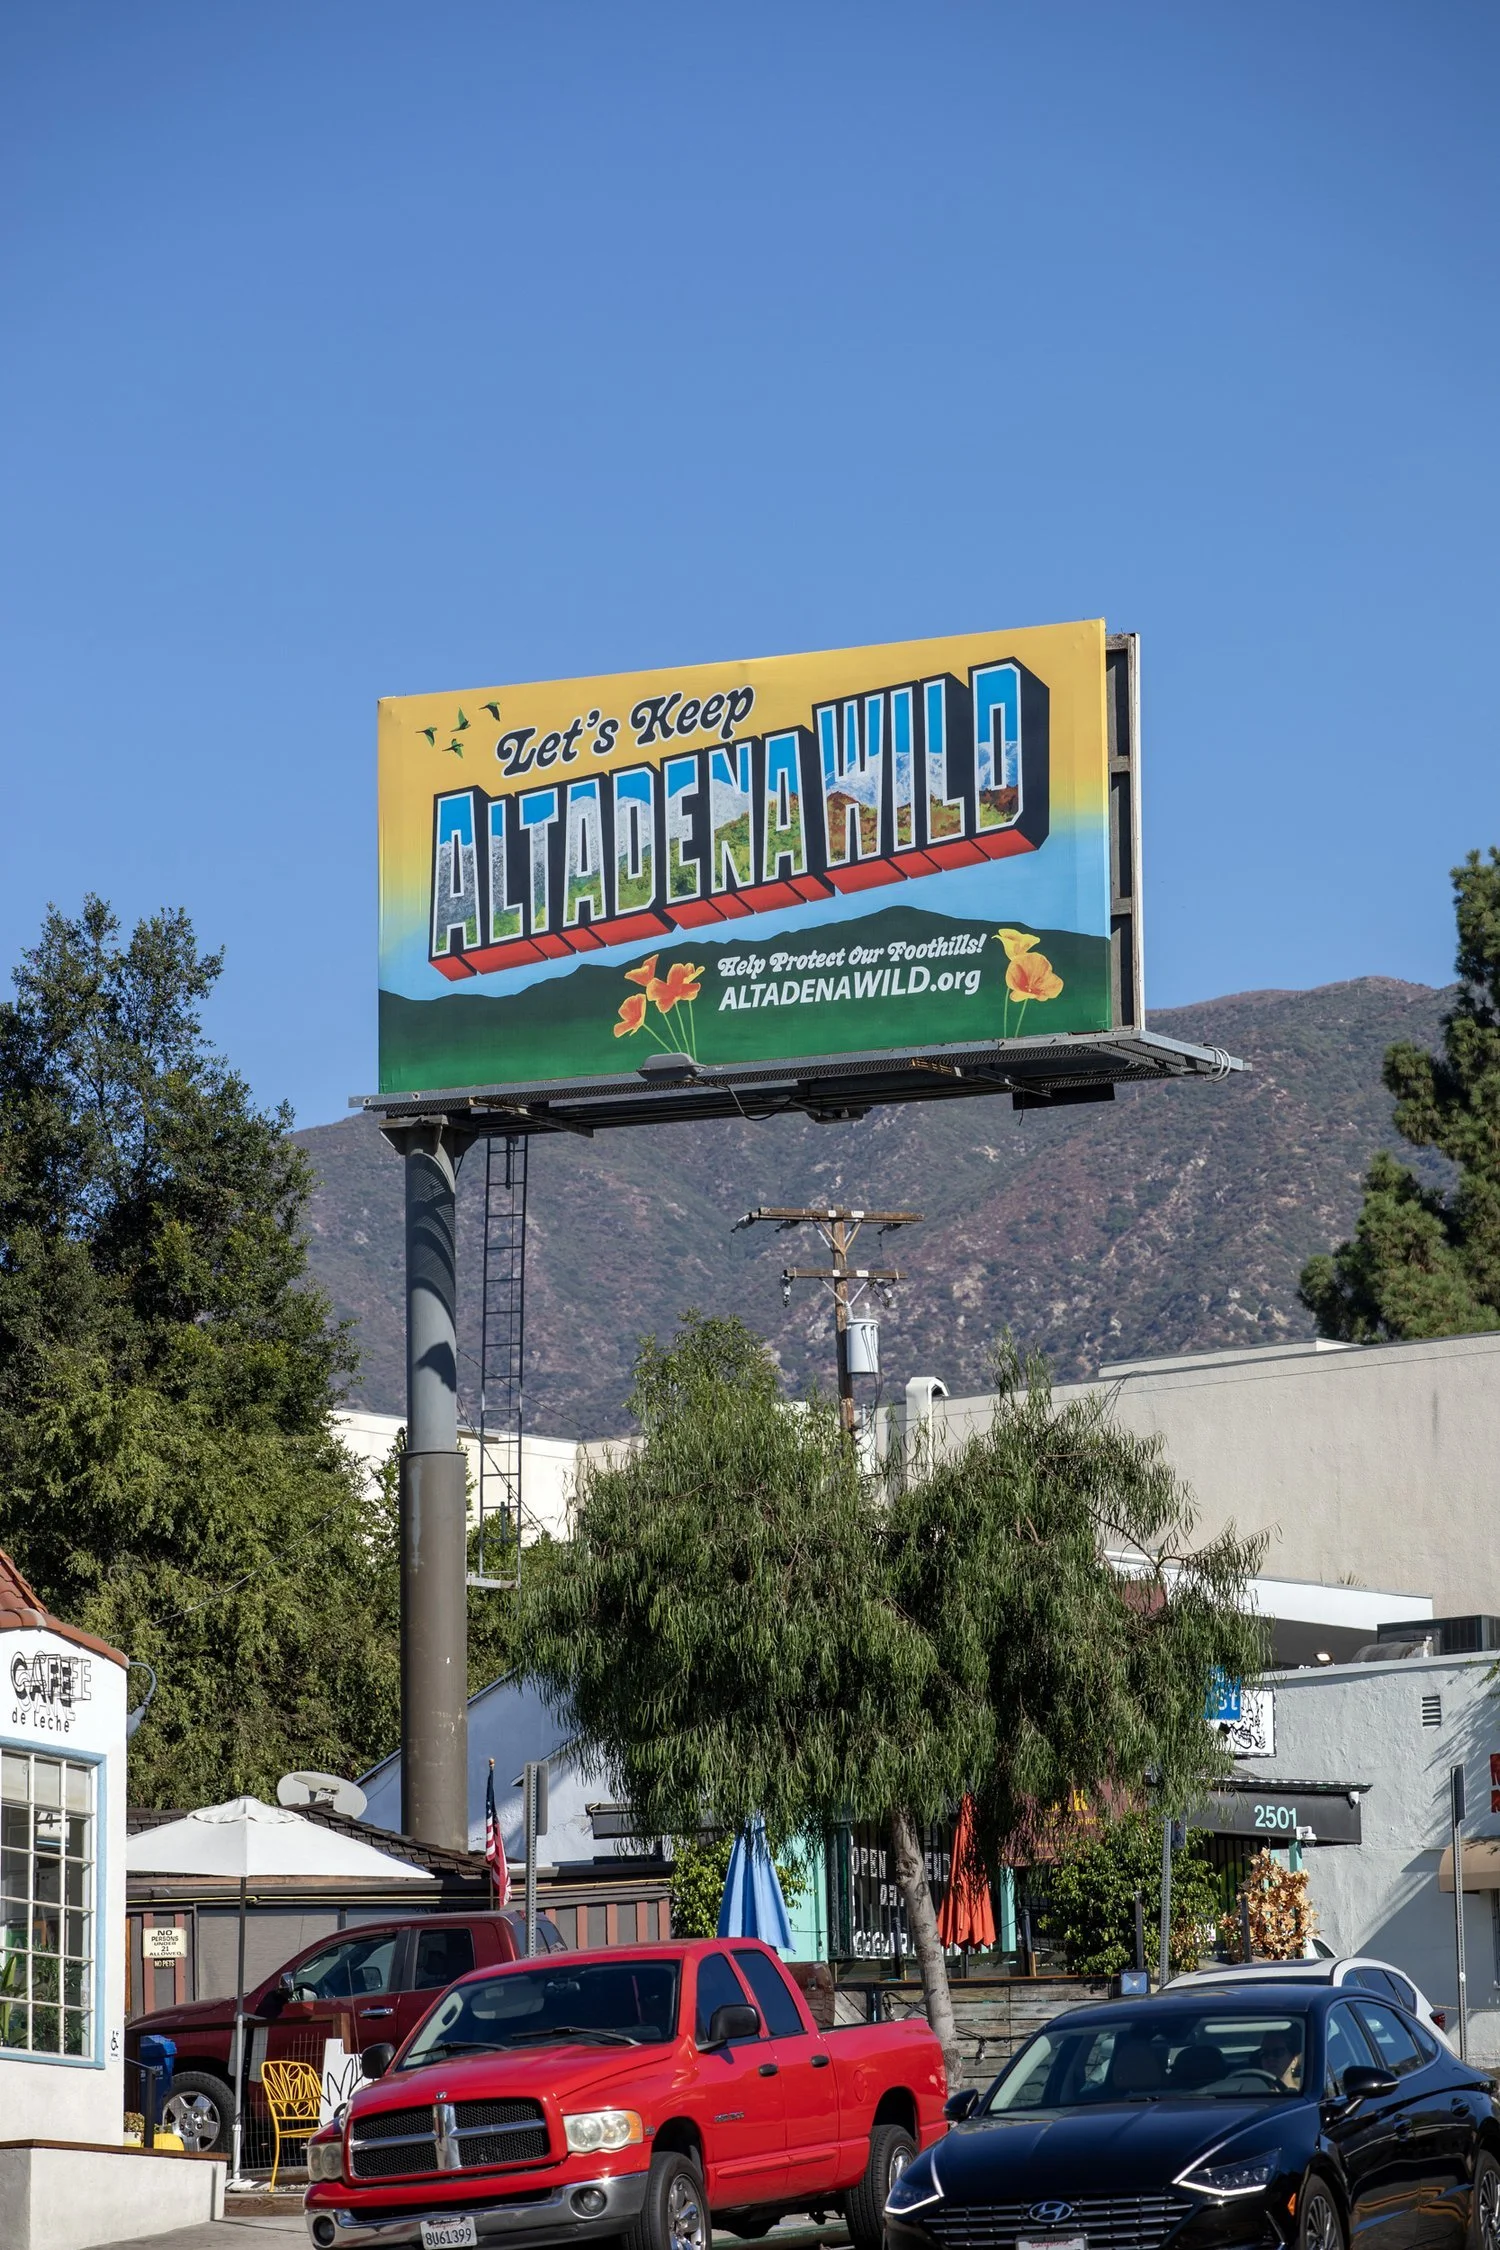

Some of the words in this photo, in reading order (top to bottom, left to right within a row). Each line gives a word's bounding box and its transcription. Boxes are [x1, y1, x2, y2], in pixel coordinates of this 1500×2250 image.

[496, 709, 620, 777] Let's
[630, 684, 755, 746] Keep
[430, 725, 815, 965] ALTADENA
[813, 659, 1035, 875] WILD
[717, 955, 766, 980] Help
[769, 948, 846, 974] Protect
[848, 945, 884, 966] Our
[886, 933, 987, 962] Foothills!
[718, 965, 982, 1012] ALTADENAWILD.org
[12, 1707, 26, 1725] de
[33, 1710, 70, 1733] leche
[1254, 1804, 1297, 1830] 2501
[852, 1846, 887, 1880] OPEN
[425, 2228, 472, 2246] 8U61399
